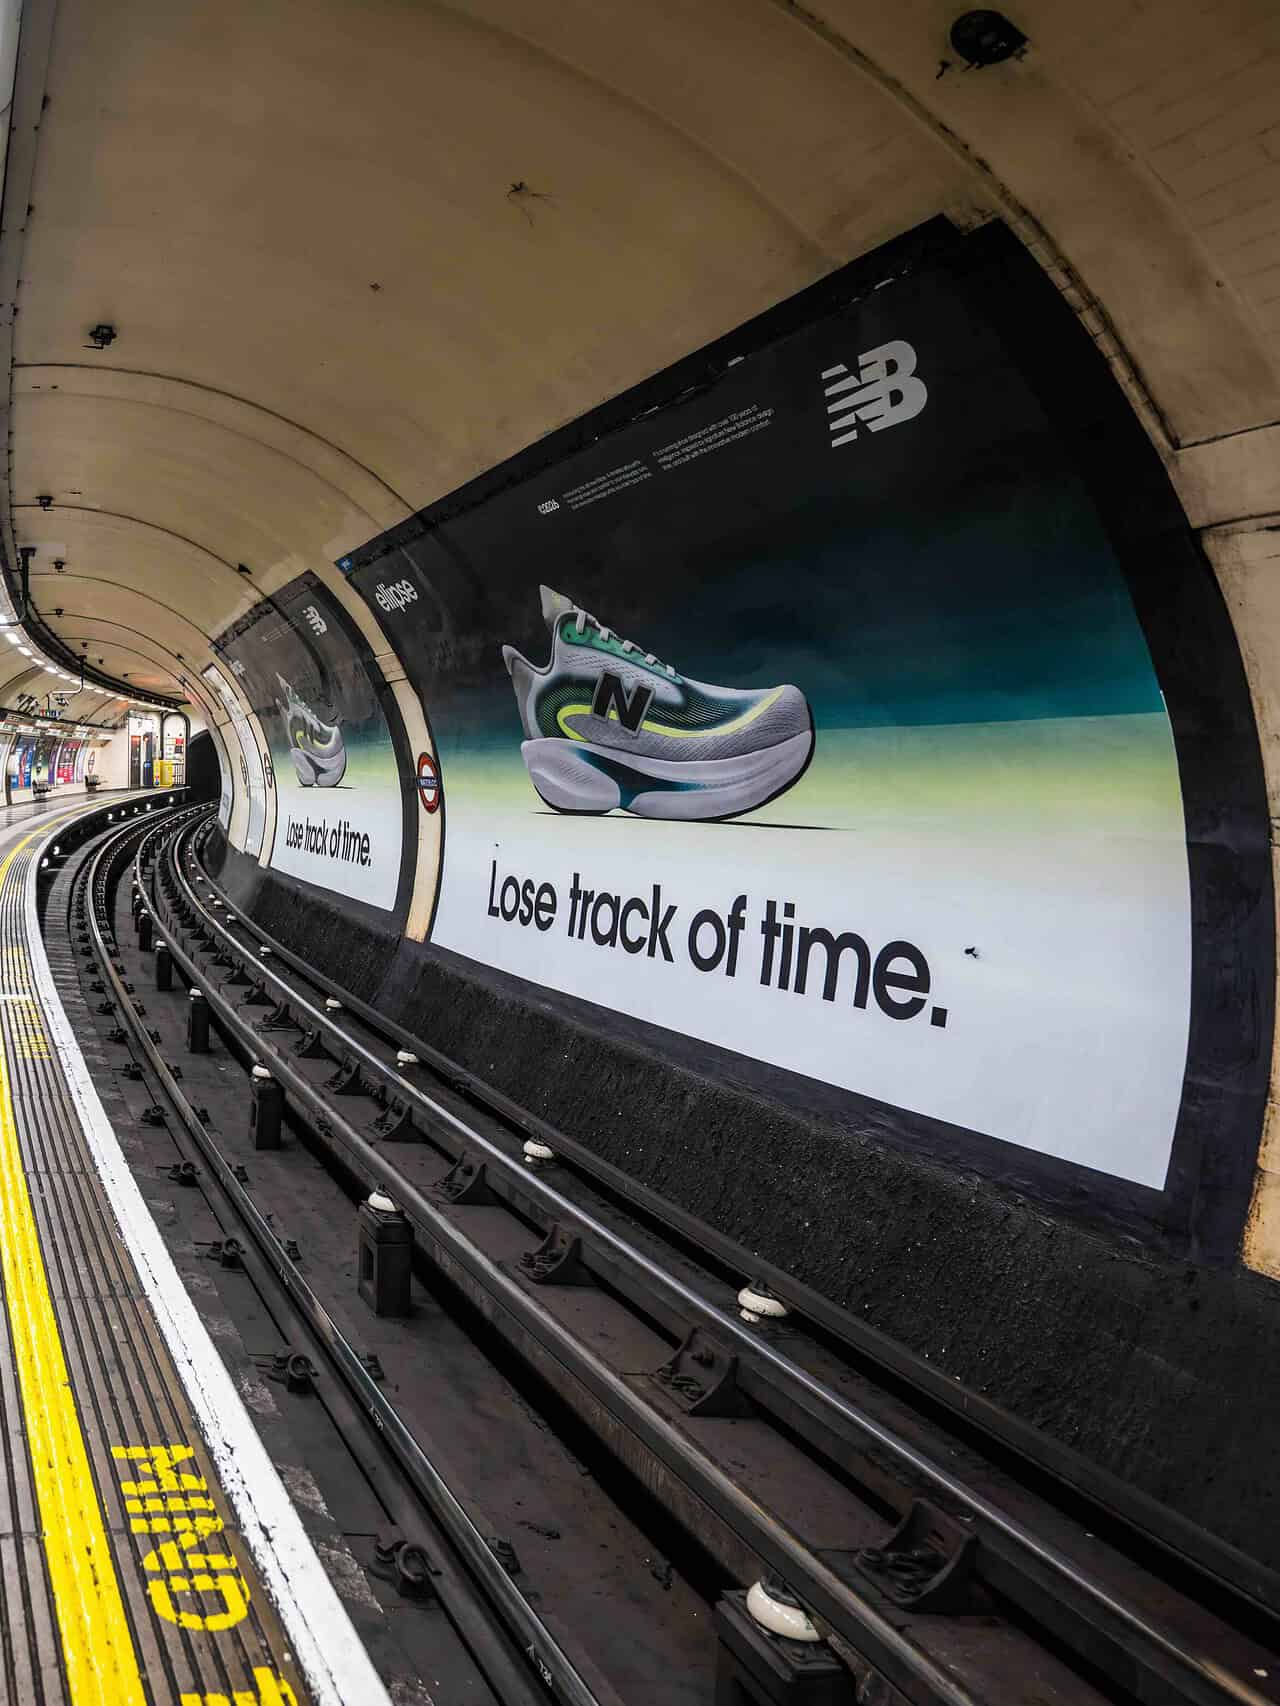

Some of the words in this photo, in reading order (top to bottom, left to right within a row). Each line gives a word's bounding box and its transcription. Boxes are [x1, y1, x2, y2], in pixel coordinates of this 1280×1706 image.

[375, 579, 418, 613] ellipse
[592, 671, 656, 738] N
[286, 815, 303, 849] Lose
[304, 817, 328, 855] track
[330, 819, 341, 858] of
[342, 821, 371, 866] time.
[487, 860, 557, 931] Lose
[568, 873, 678, 963] track
[688, 894, 747, 977] of
[760, 900, 948, 1028] time.
[110, 1444, 251, 1632] MIND
